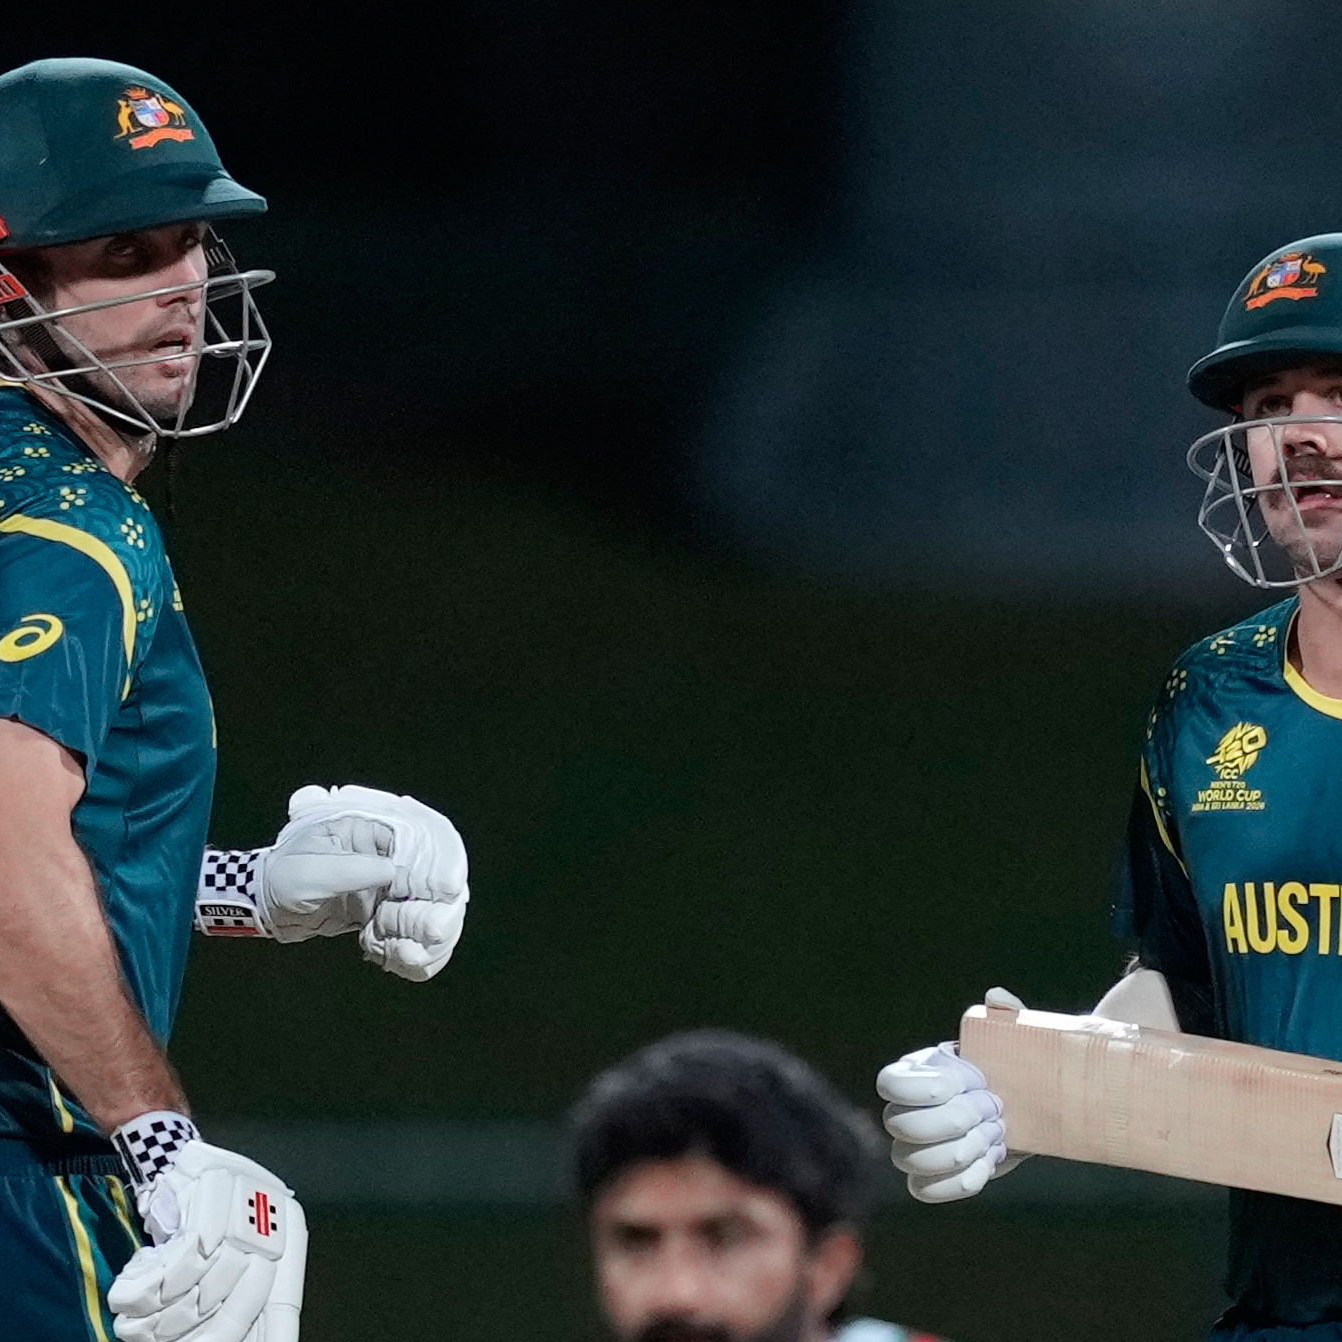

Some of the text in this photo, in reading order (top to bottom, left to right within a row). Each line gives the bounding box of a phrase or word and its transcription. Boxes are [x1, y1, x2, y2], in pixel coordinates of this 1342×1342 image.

[1198, 789, 1262, 802] WORLD CUP
[204, 905, 246, 917] SILVER
